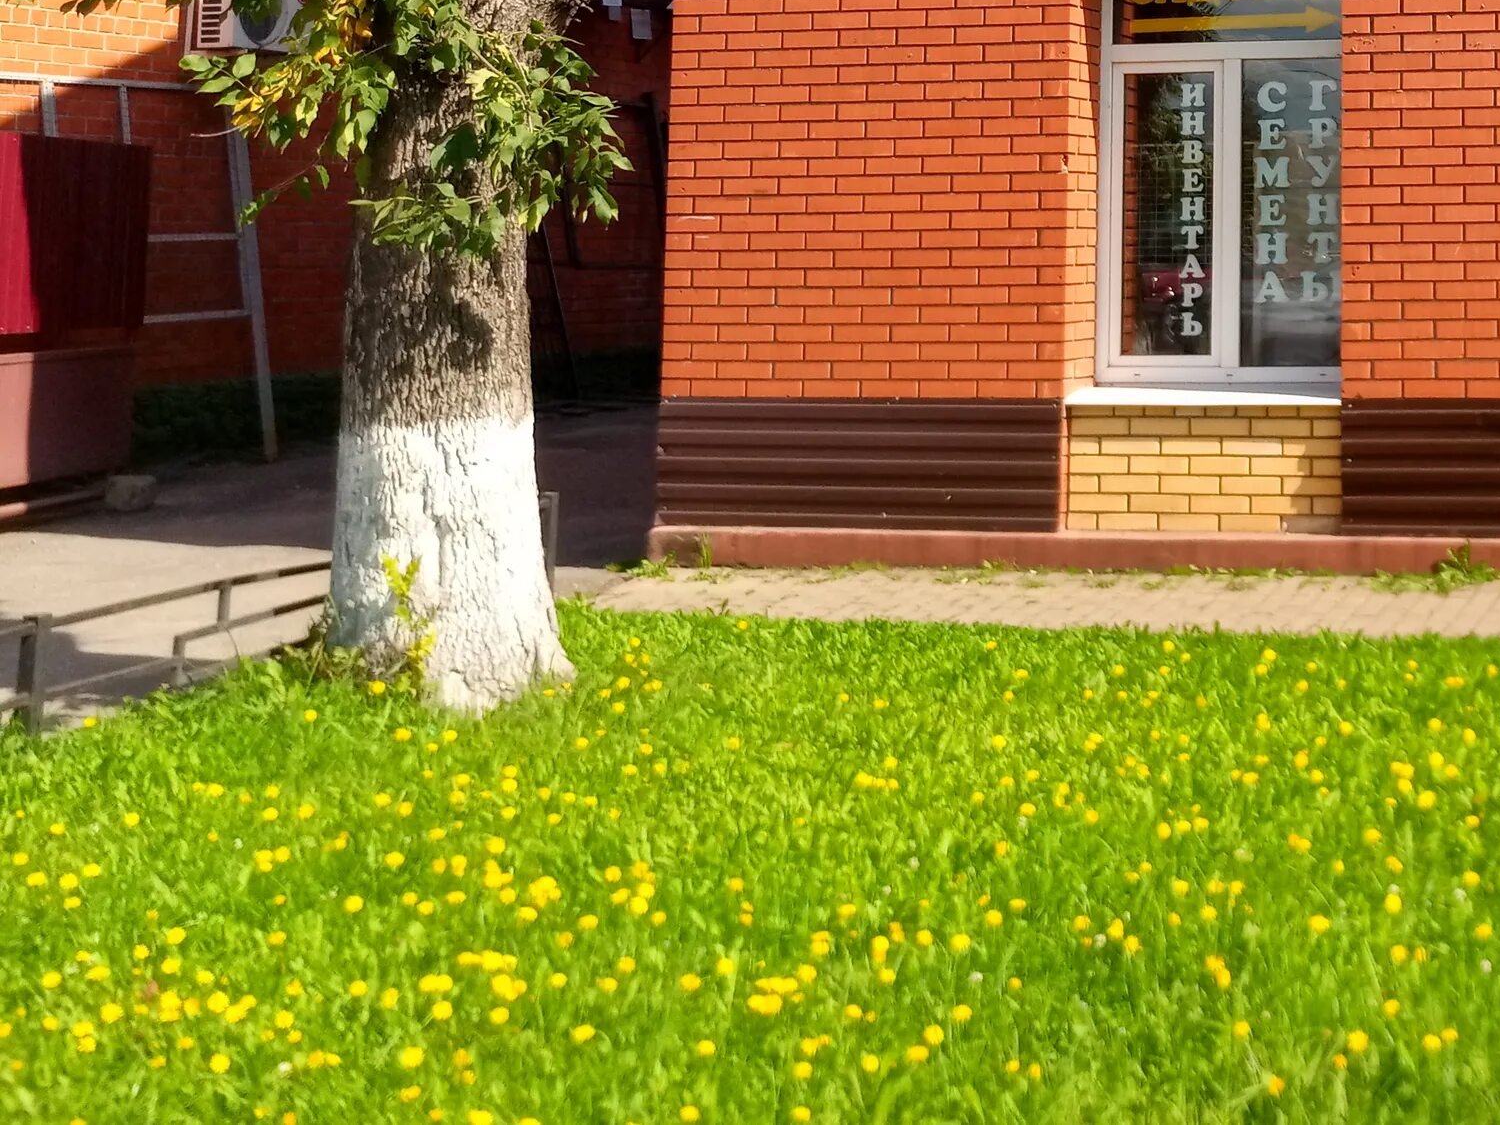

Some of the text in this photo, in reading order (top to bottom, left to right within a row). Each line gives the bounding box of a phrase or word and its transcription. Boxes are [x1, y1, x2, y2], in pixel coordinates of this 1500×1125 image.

[1179, 82, 1206, 338] ИНВЕНТАРЬ
[1254, 80, 1290, 304] СЕМЕНА
[1302, 79, 1340, 303] ГРУНТЫ
